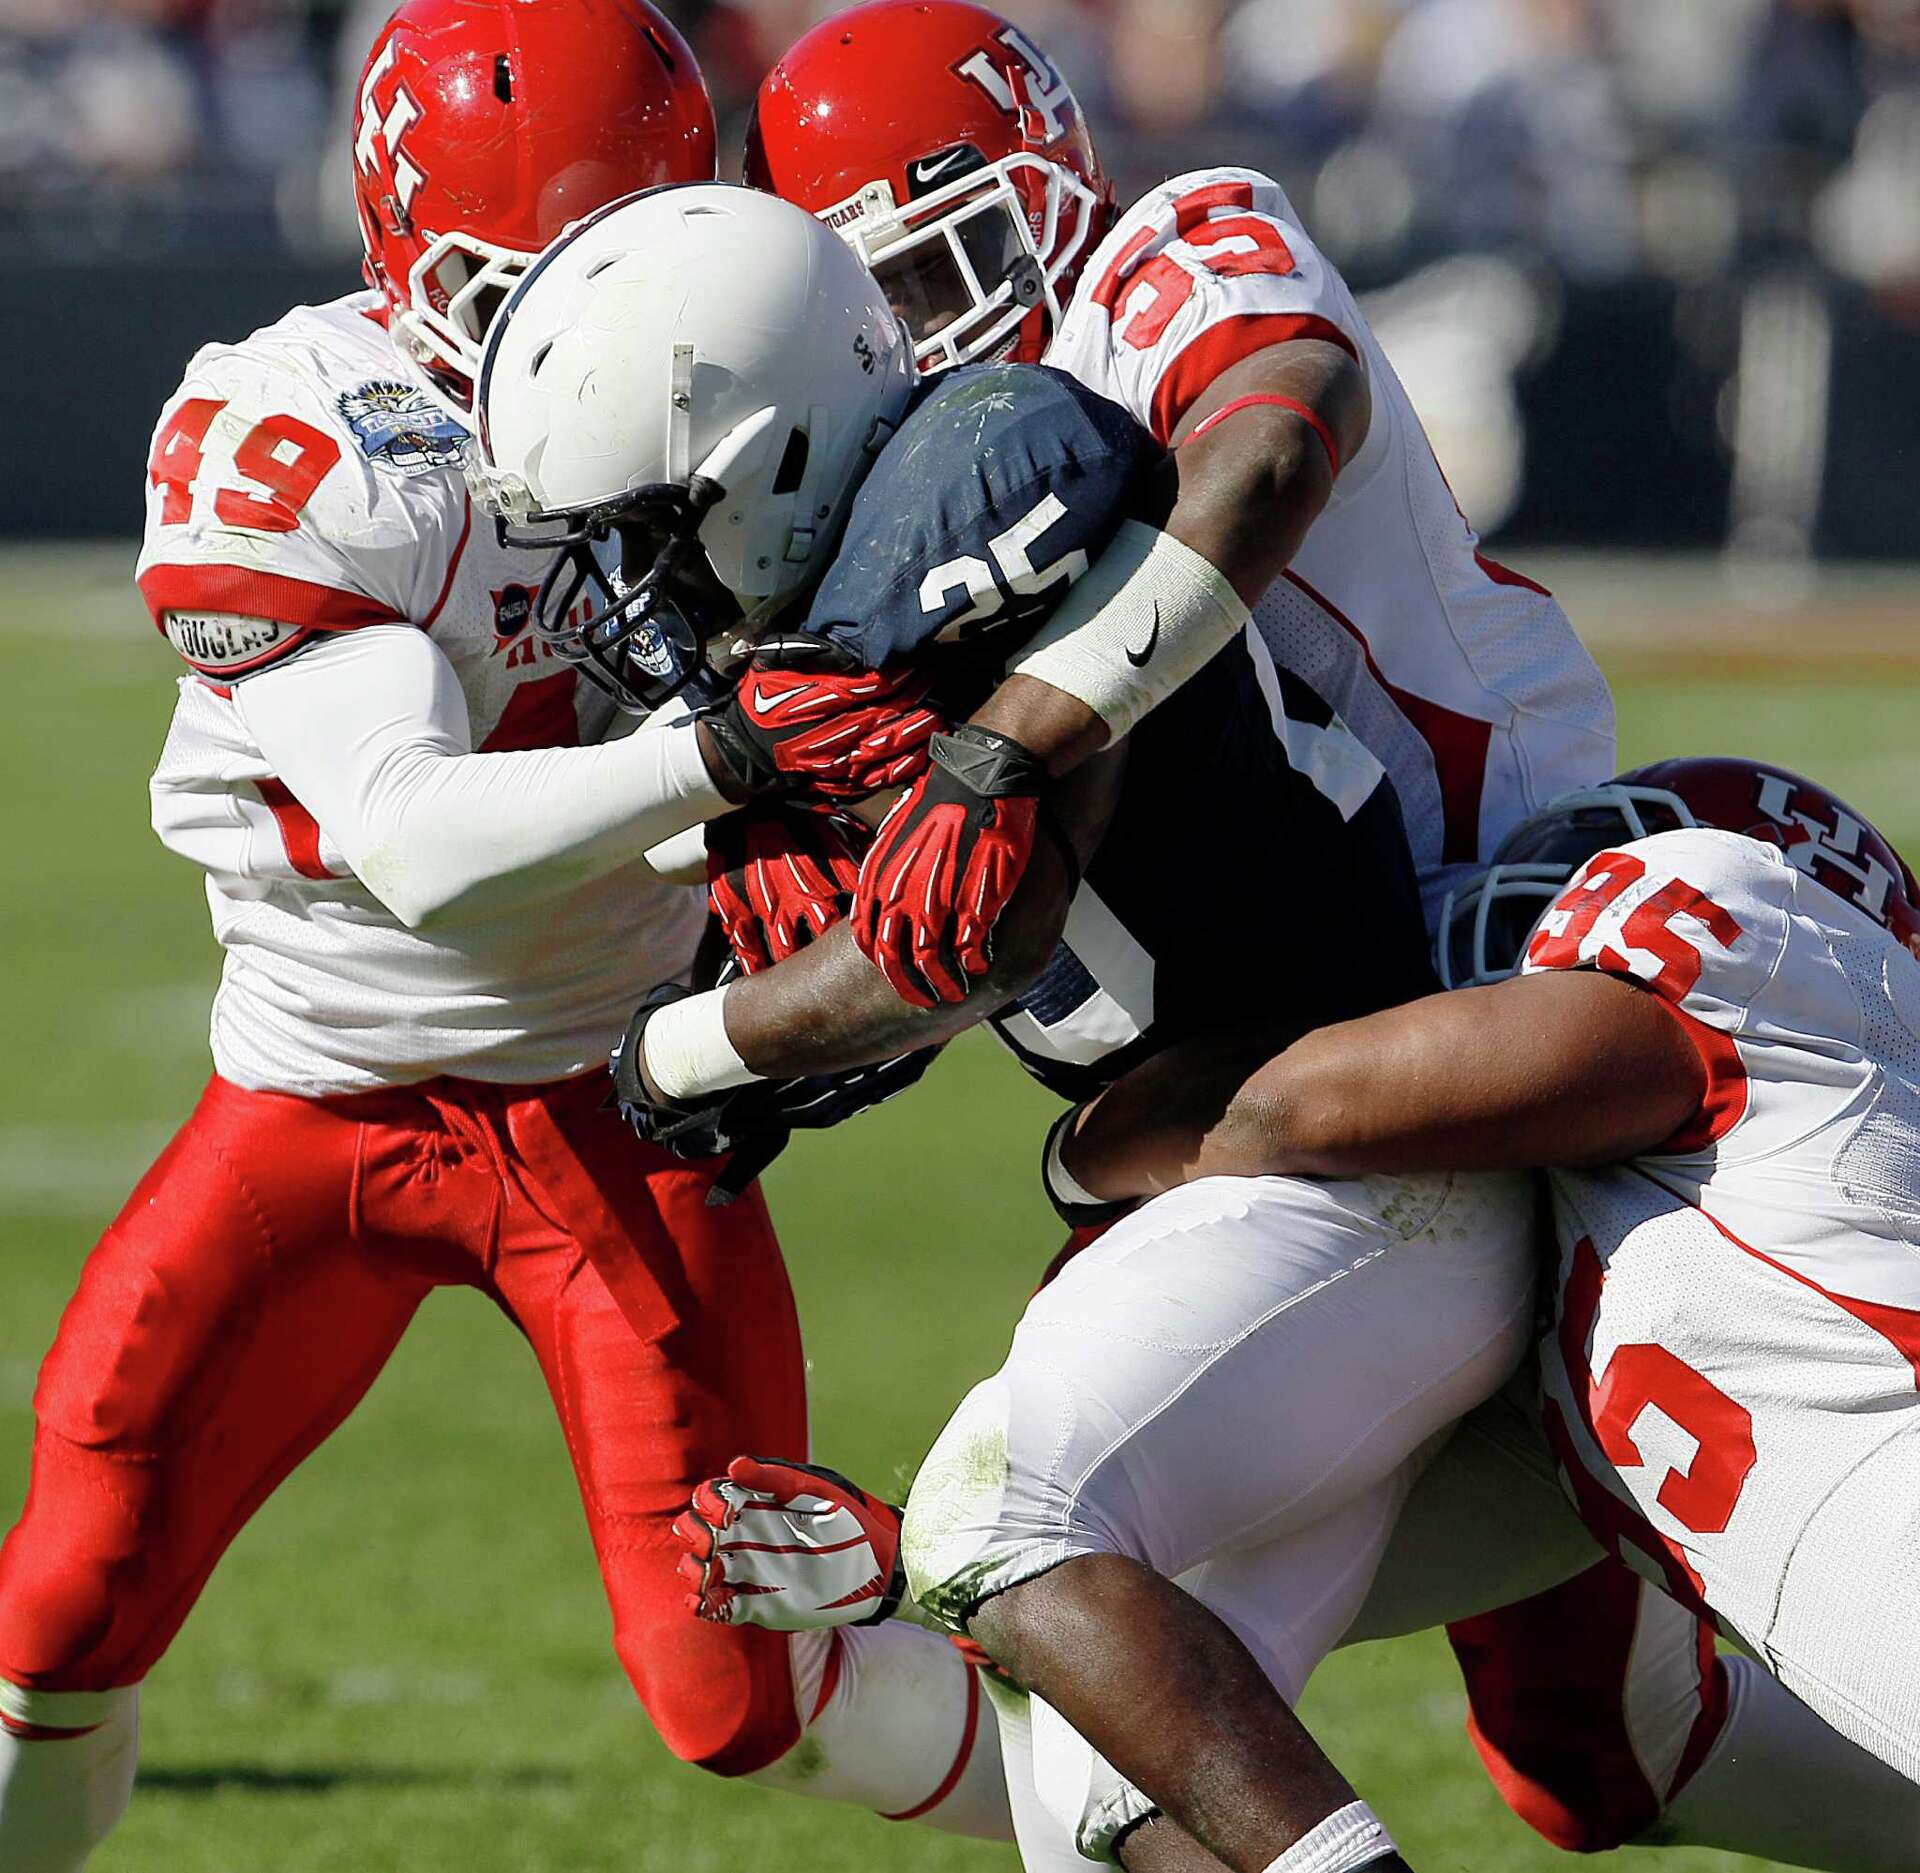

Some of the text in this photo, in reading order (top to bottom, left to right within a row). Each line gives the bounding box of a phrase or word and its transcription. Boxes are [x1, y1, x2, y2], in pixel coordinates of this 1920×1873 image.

[1091, 181, 1296, 351] 55
[150, 398, 342, 533] 49
[918, 492, 1090, 643] 25
[1756, 772, 1896, 923] UH
[1528, 851, 1744, 1004] 95
